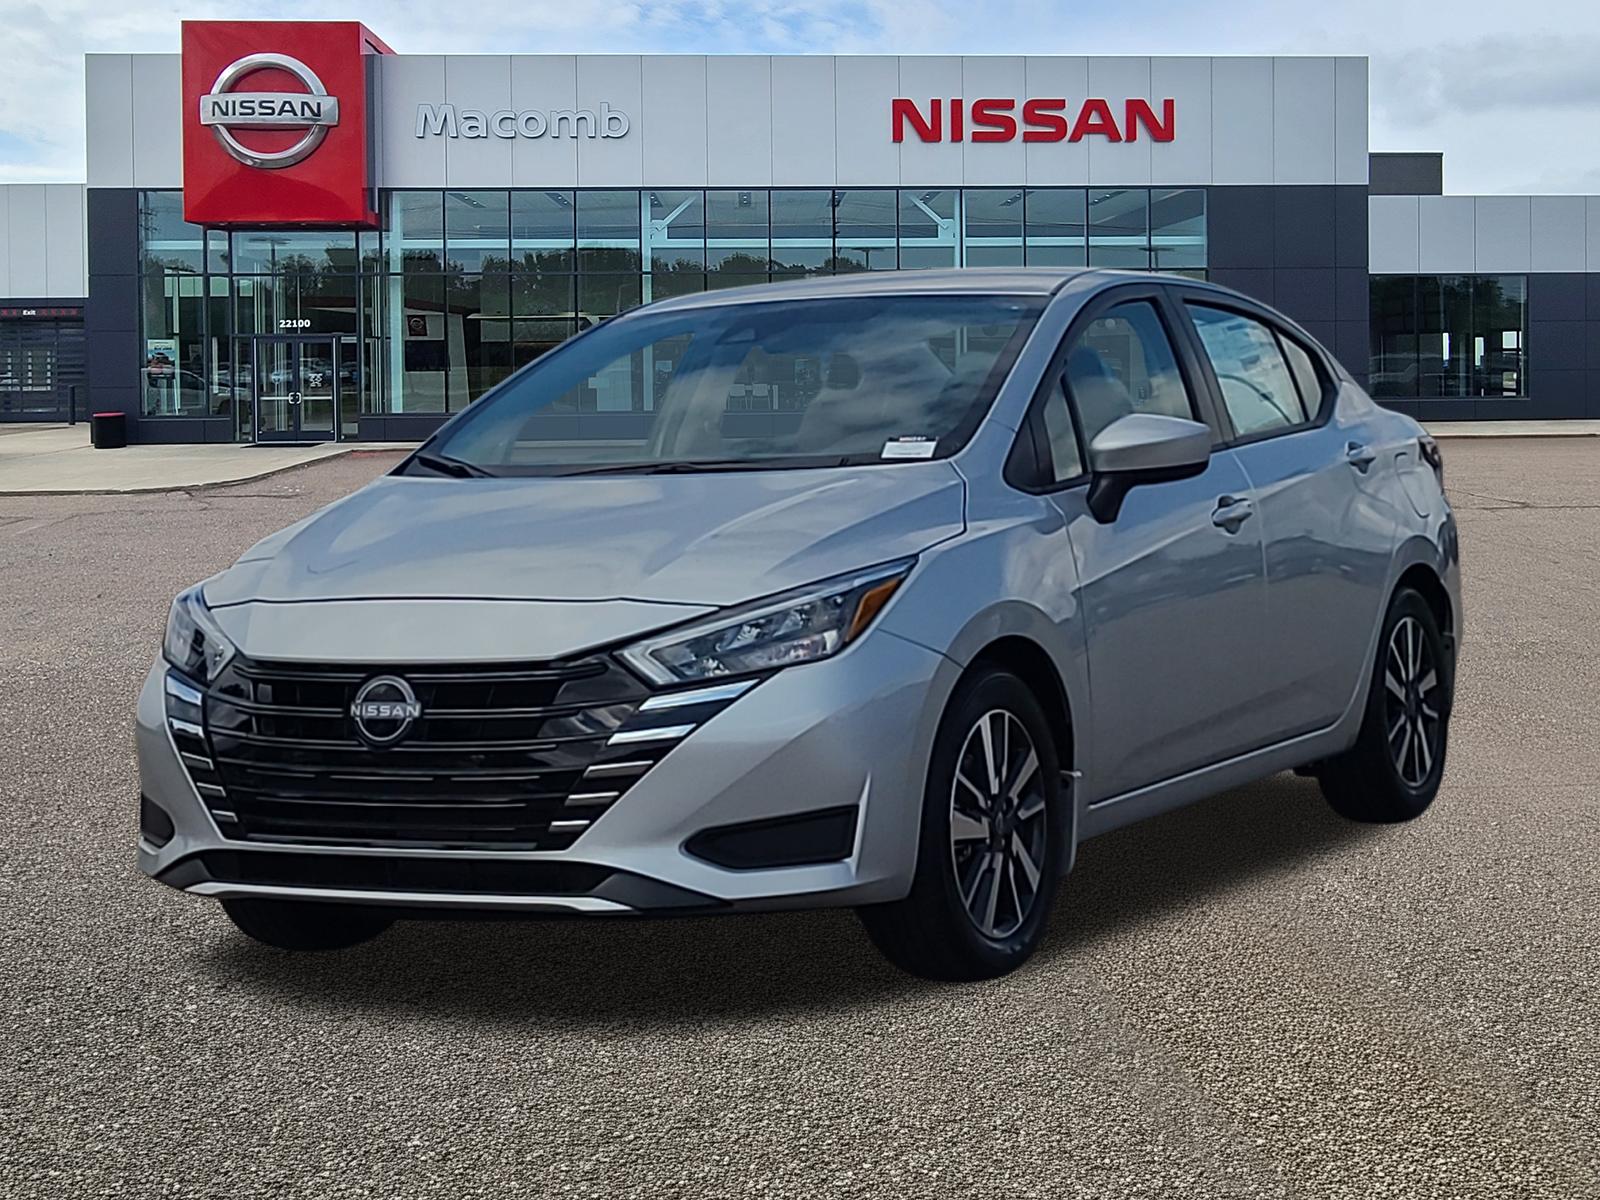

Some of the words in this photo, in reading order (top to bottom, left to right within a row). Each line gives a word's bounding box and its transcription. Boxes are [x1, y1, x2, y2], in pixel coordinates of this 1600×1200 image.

[212, 100, 321, 117] NISSAN
[415, 102, 630, 139] Macomb
[892, 98, 1175, 143] NISSAN
[279, 319, 311, 328] 22100
[350, 703, 421, 717] NISSAN
